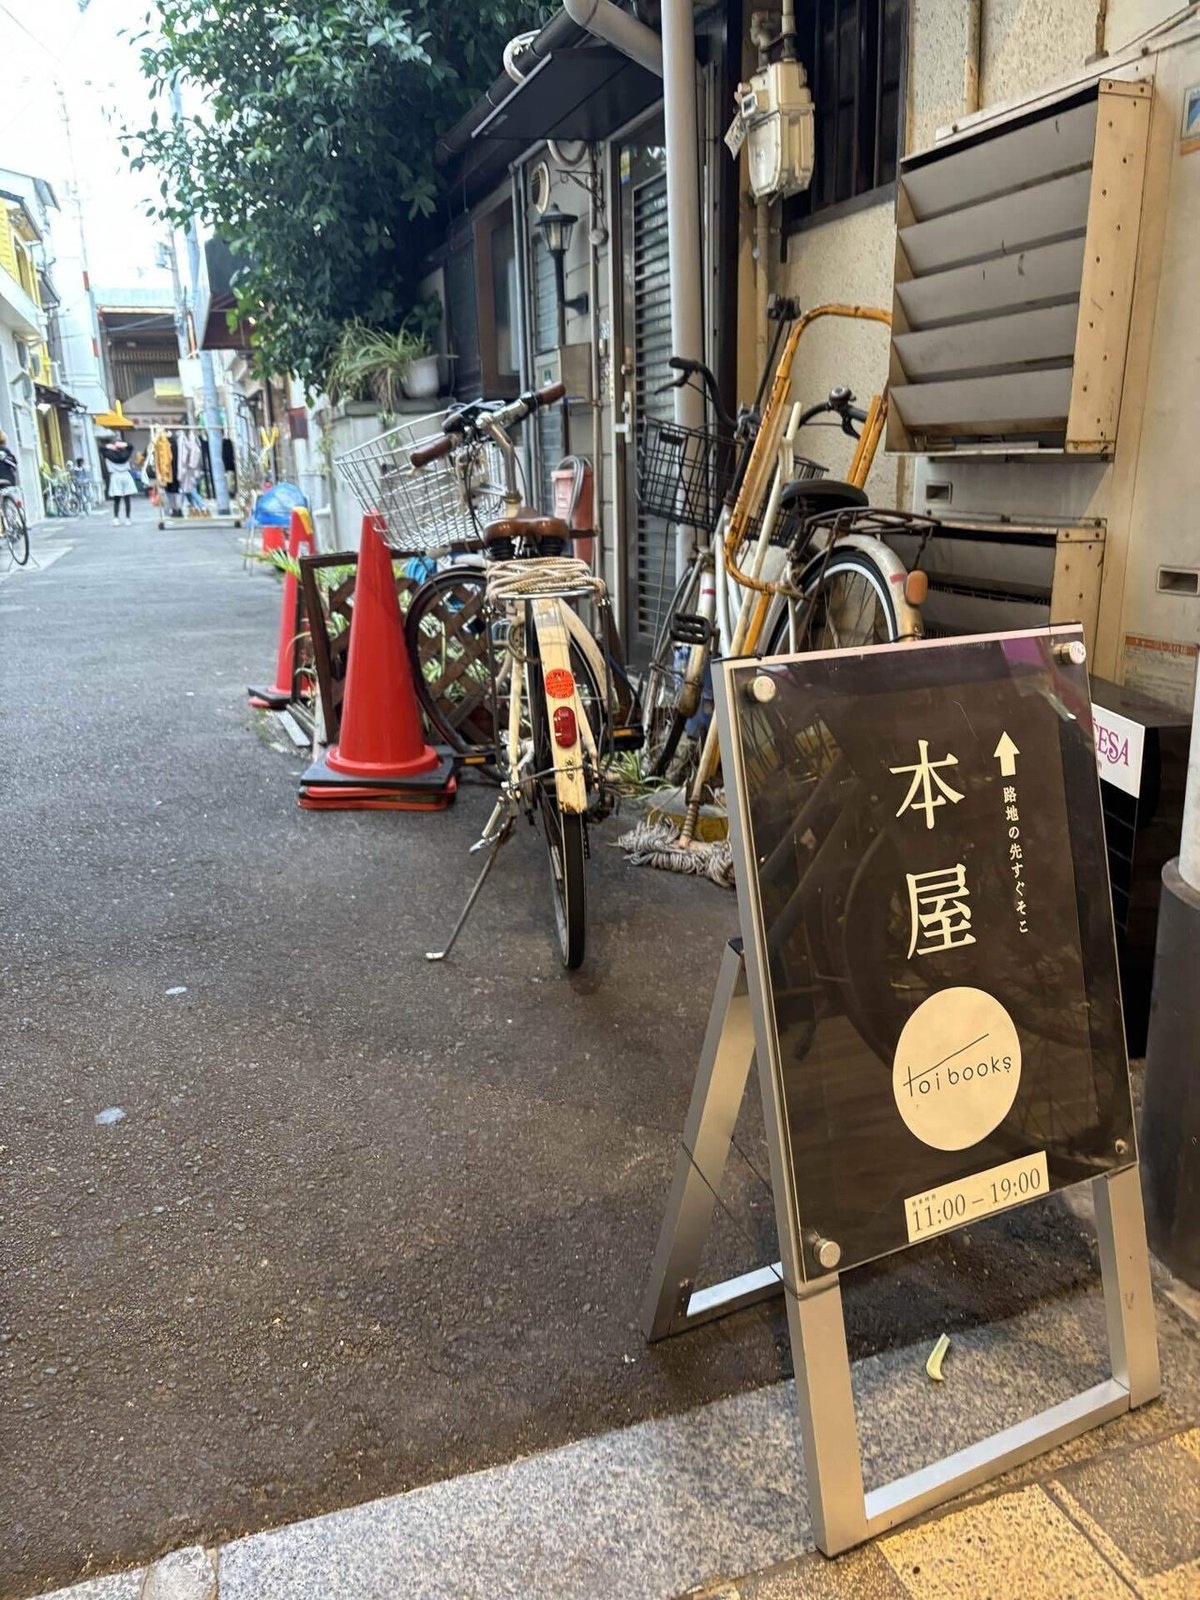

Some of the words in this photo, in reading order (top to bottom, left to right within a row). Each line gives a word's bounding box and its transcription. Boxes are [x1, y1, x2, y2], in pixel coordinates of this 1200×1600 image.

[1093, 717, 1130, 766] ESA
[889, 739, 977, 960] 本屋
[1003, 786, 1029, 934] 路地の先すぐそこ
[913, 1194, 966, 1233] 11:00
[990, 1168, 1041, 1205] 19:00
